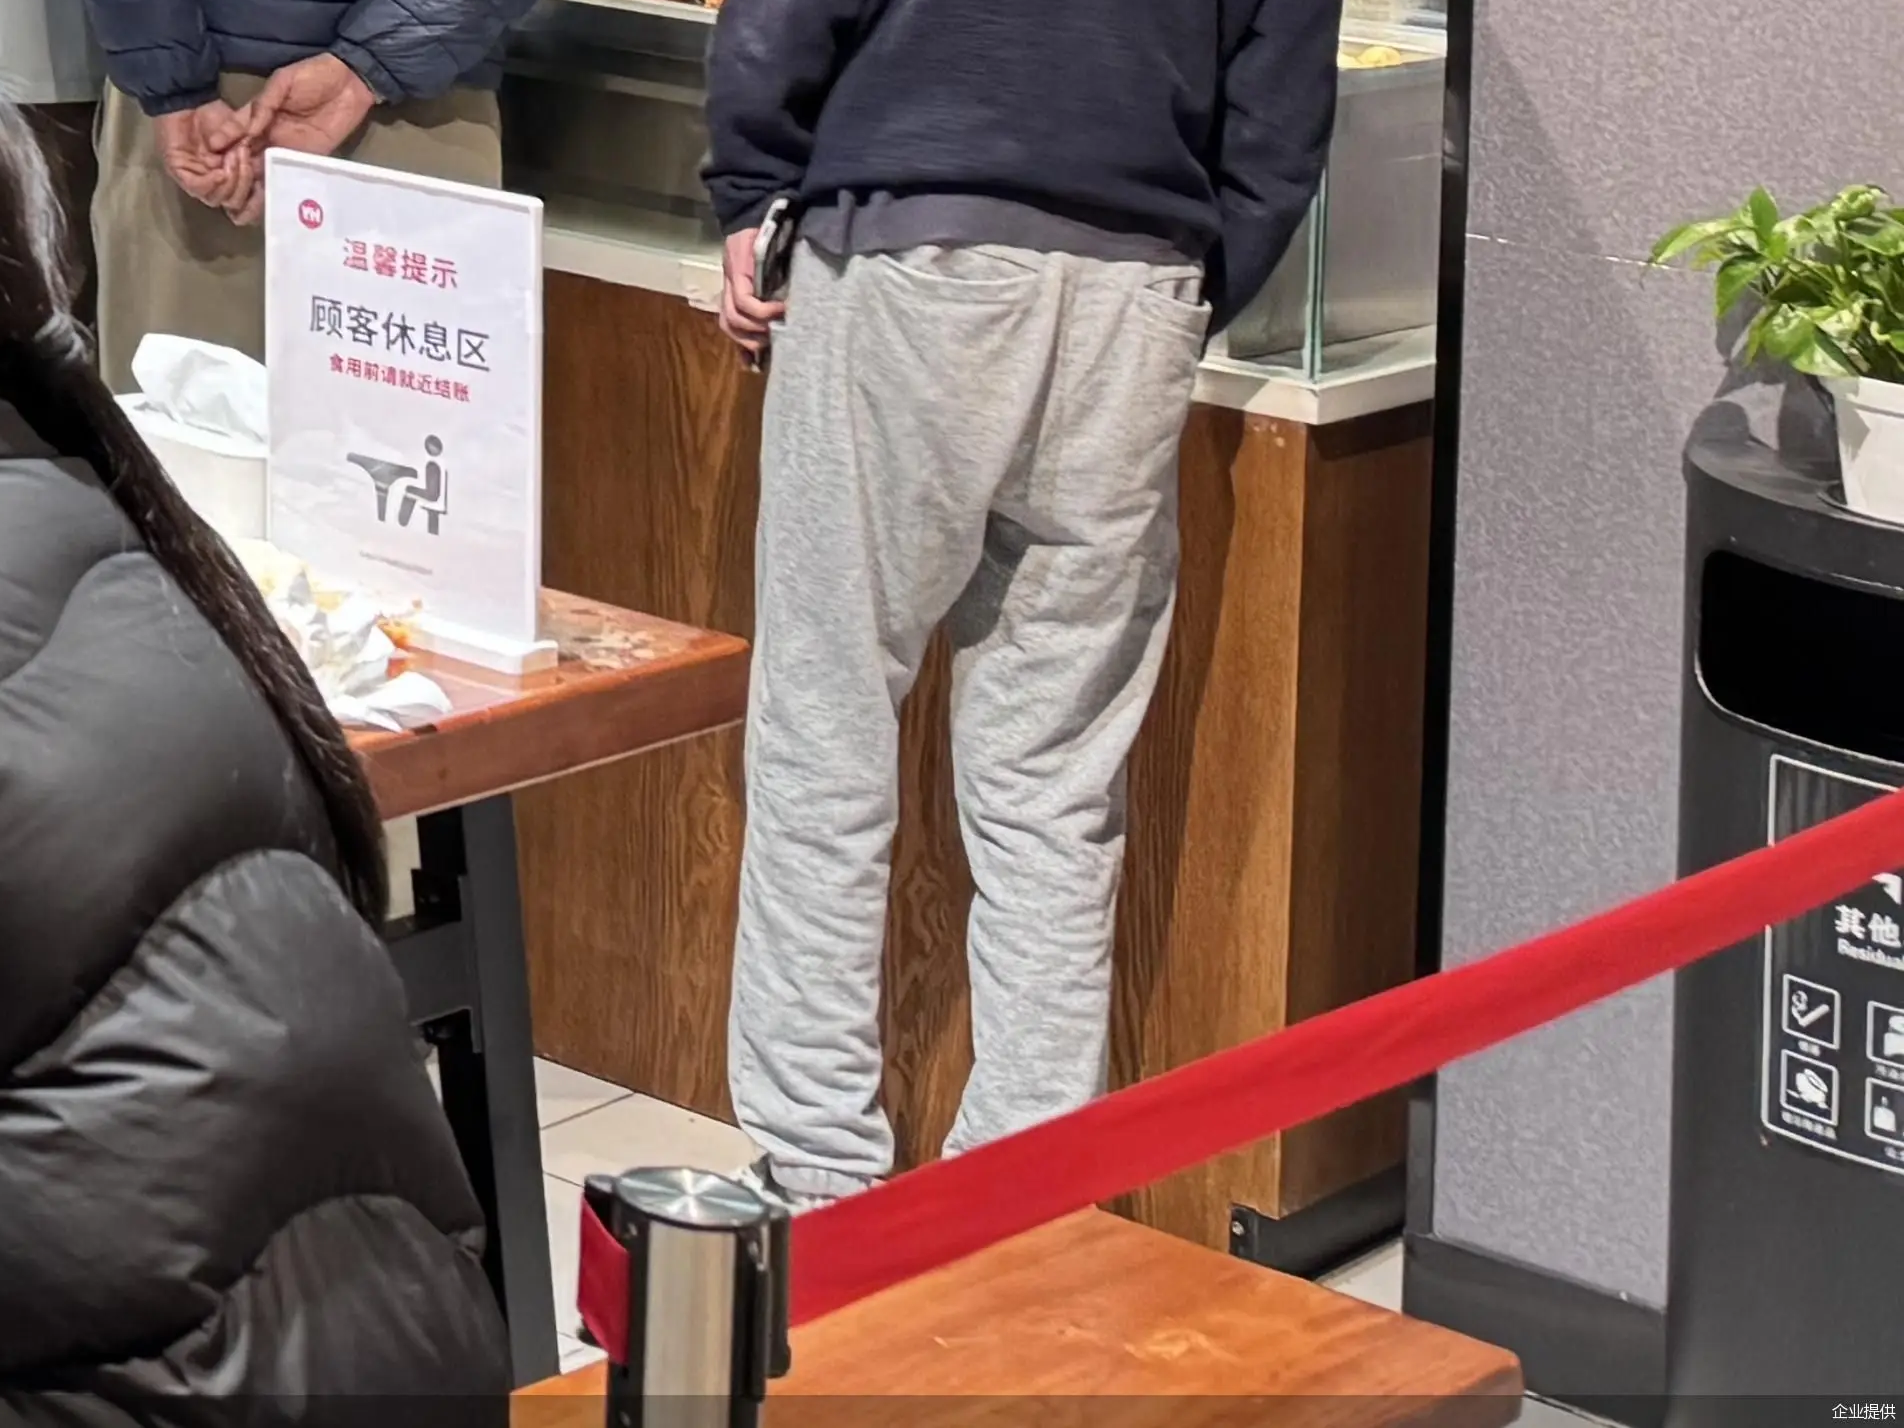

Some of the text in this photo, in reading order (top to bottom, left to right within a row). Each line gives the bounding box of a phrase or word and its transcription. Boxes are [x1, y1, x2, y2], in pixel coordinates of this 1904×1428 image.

[301, 204, 322, 225] YH
[343, 237, 458, 290] 温馨提示
[309, 294, 491, 373] 顾客休息区
[329, 352, 471, 404] 食用前请就近结账
[1834, 904, 1902, 948] 其他
